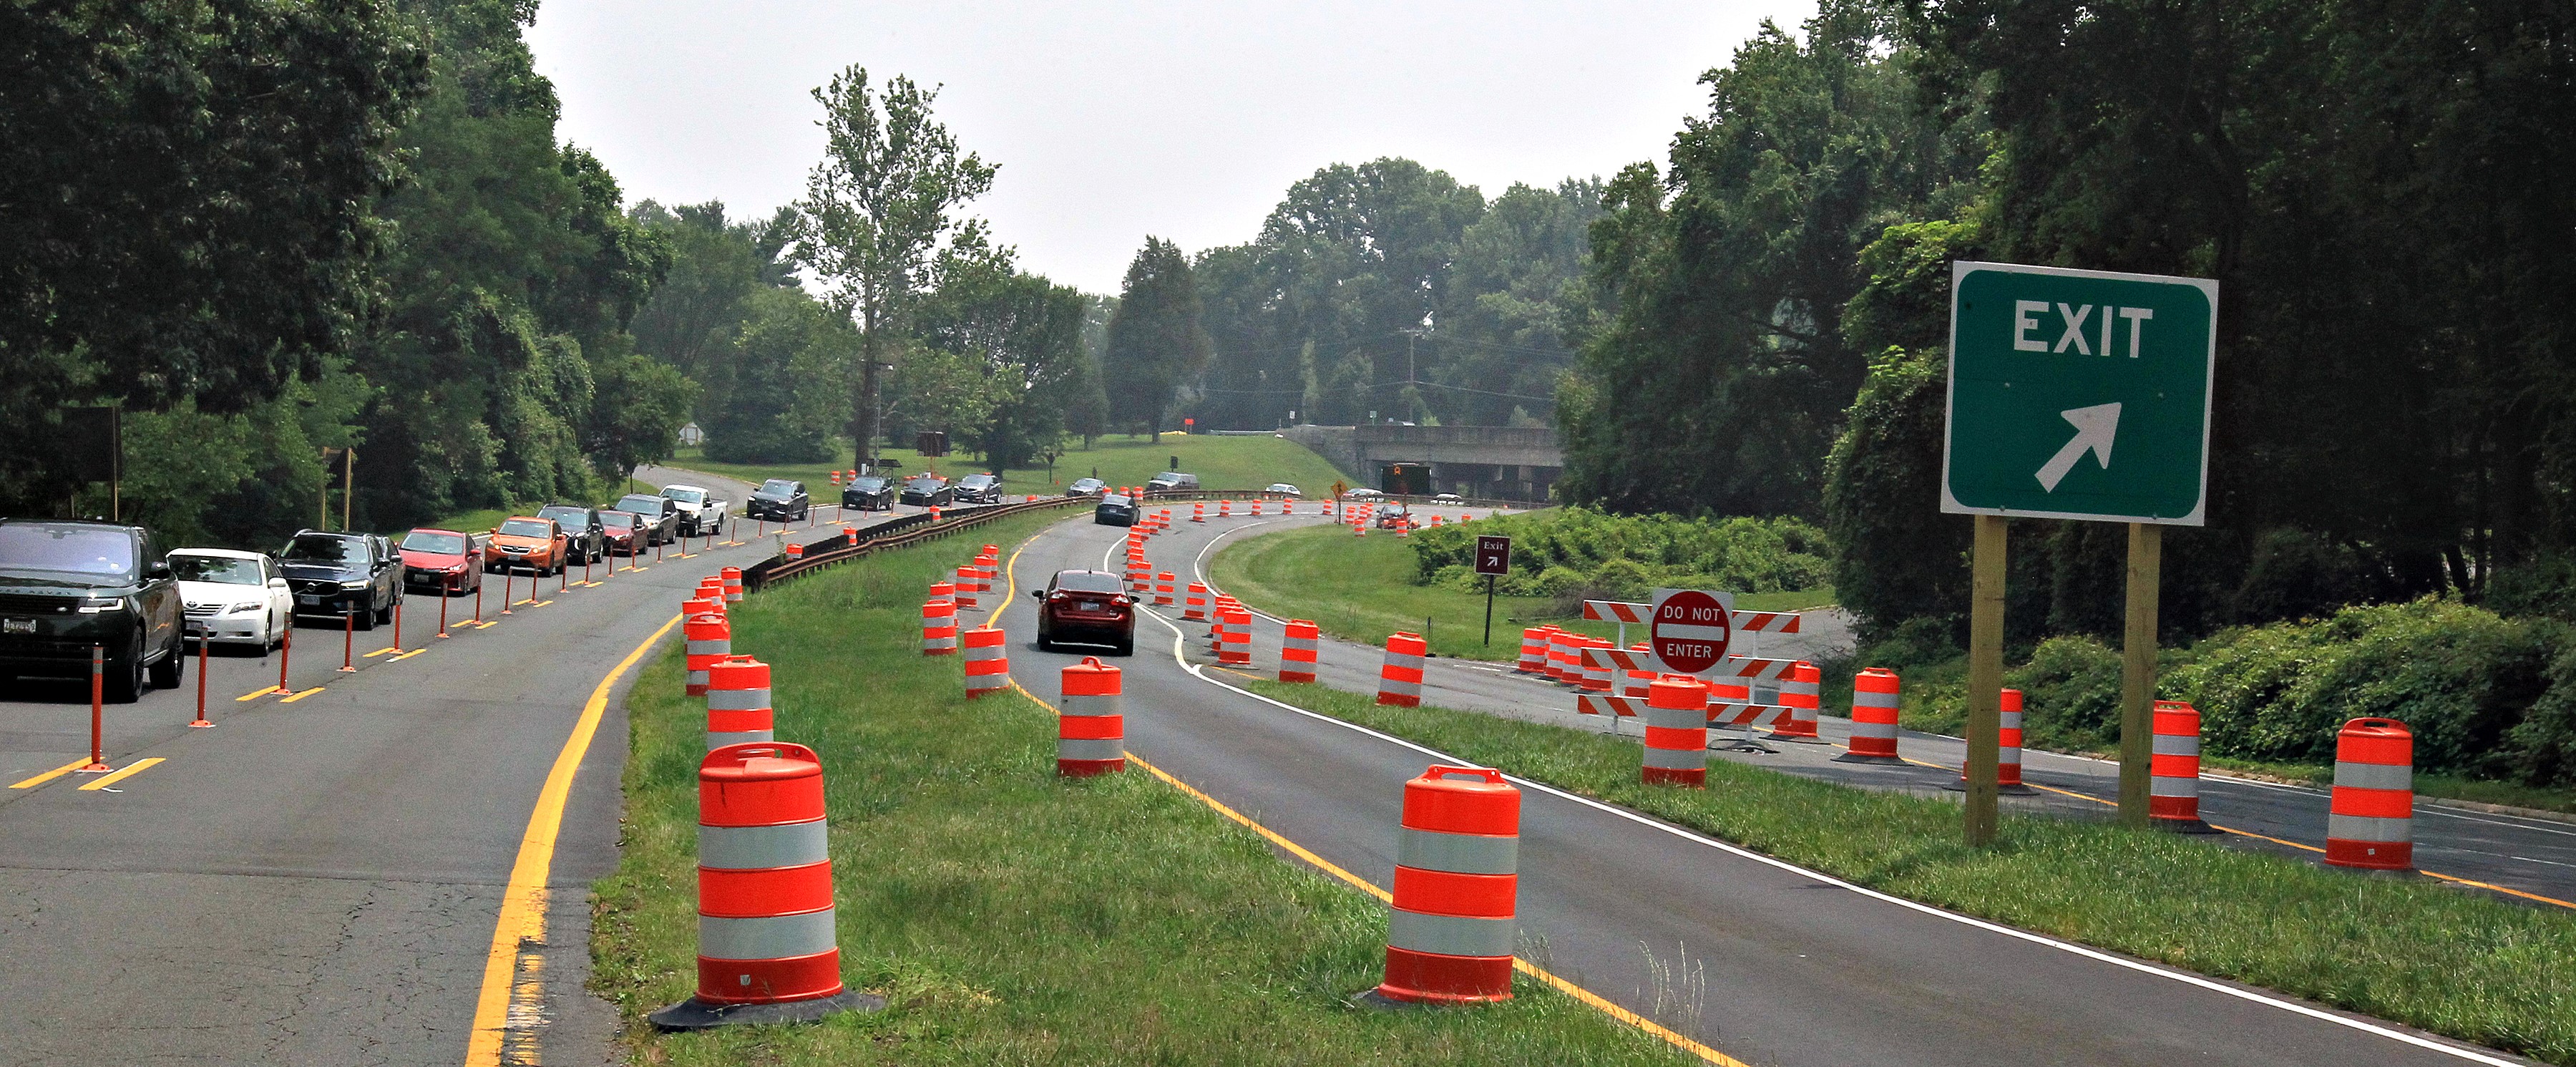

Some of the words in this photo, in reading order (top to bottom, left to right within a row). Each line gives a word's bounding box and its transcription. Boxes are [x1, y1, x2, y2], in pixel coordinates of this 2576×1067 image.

[2014, 299, 2153, 358] EXIT
[1484, 541, 1503, 550] Exit
[1664, 605, 1684, 619] DO
[1692, 607, 1720, 621] NOT
[1667, 643, 1712, 658] ENTER
